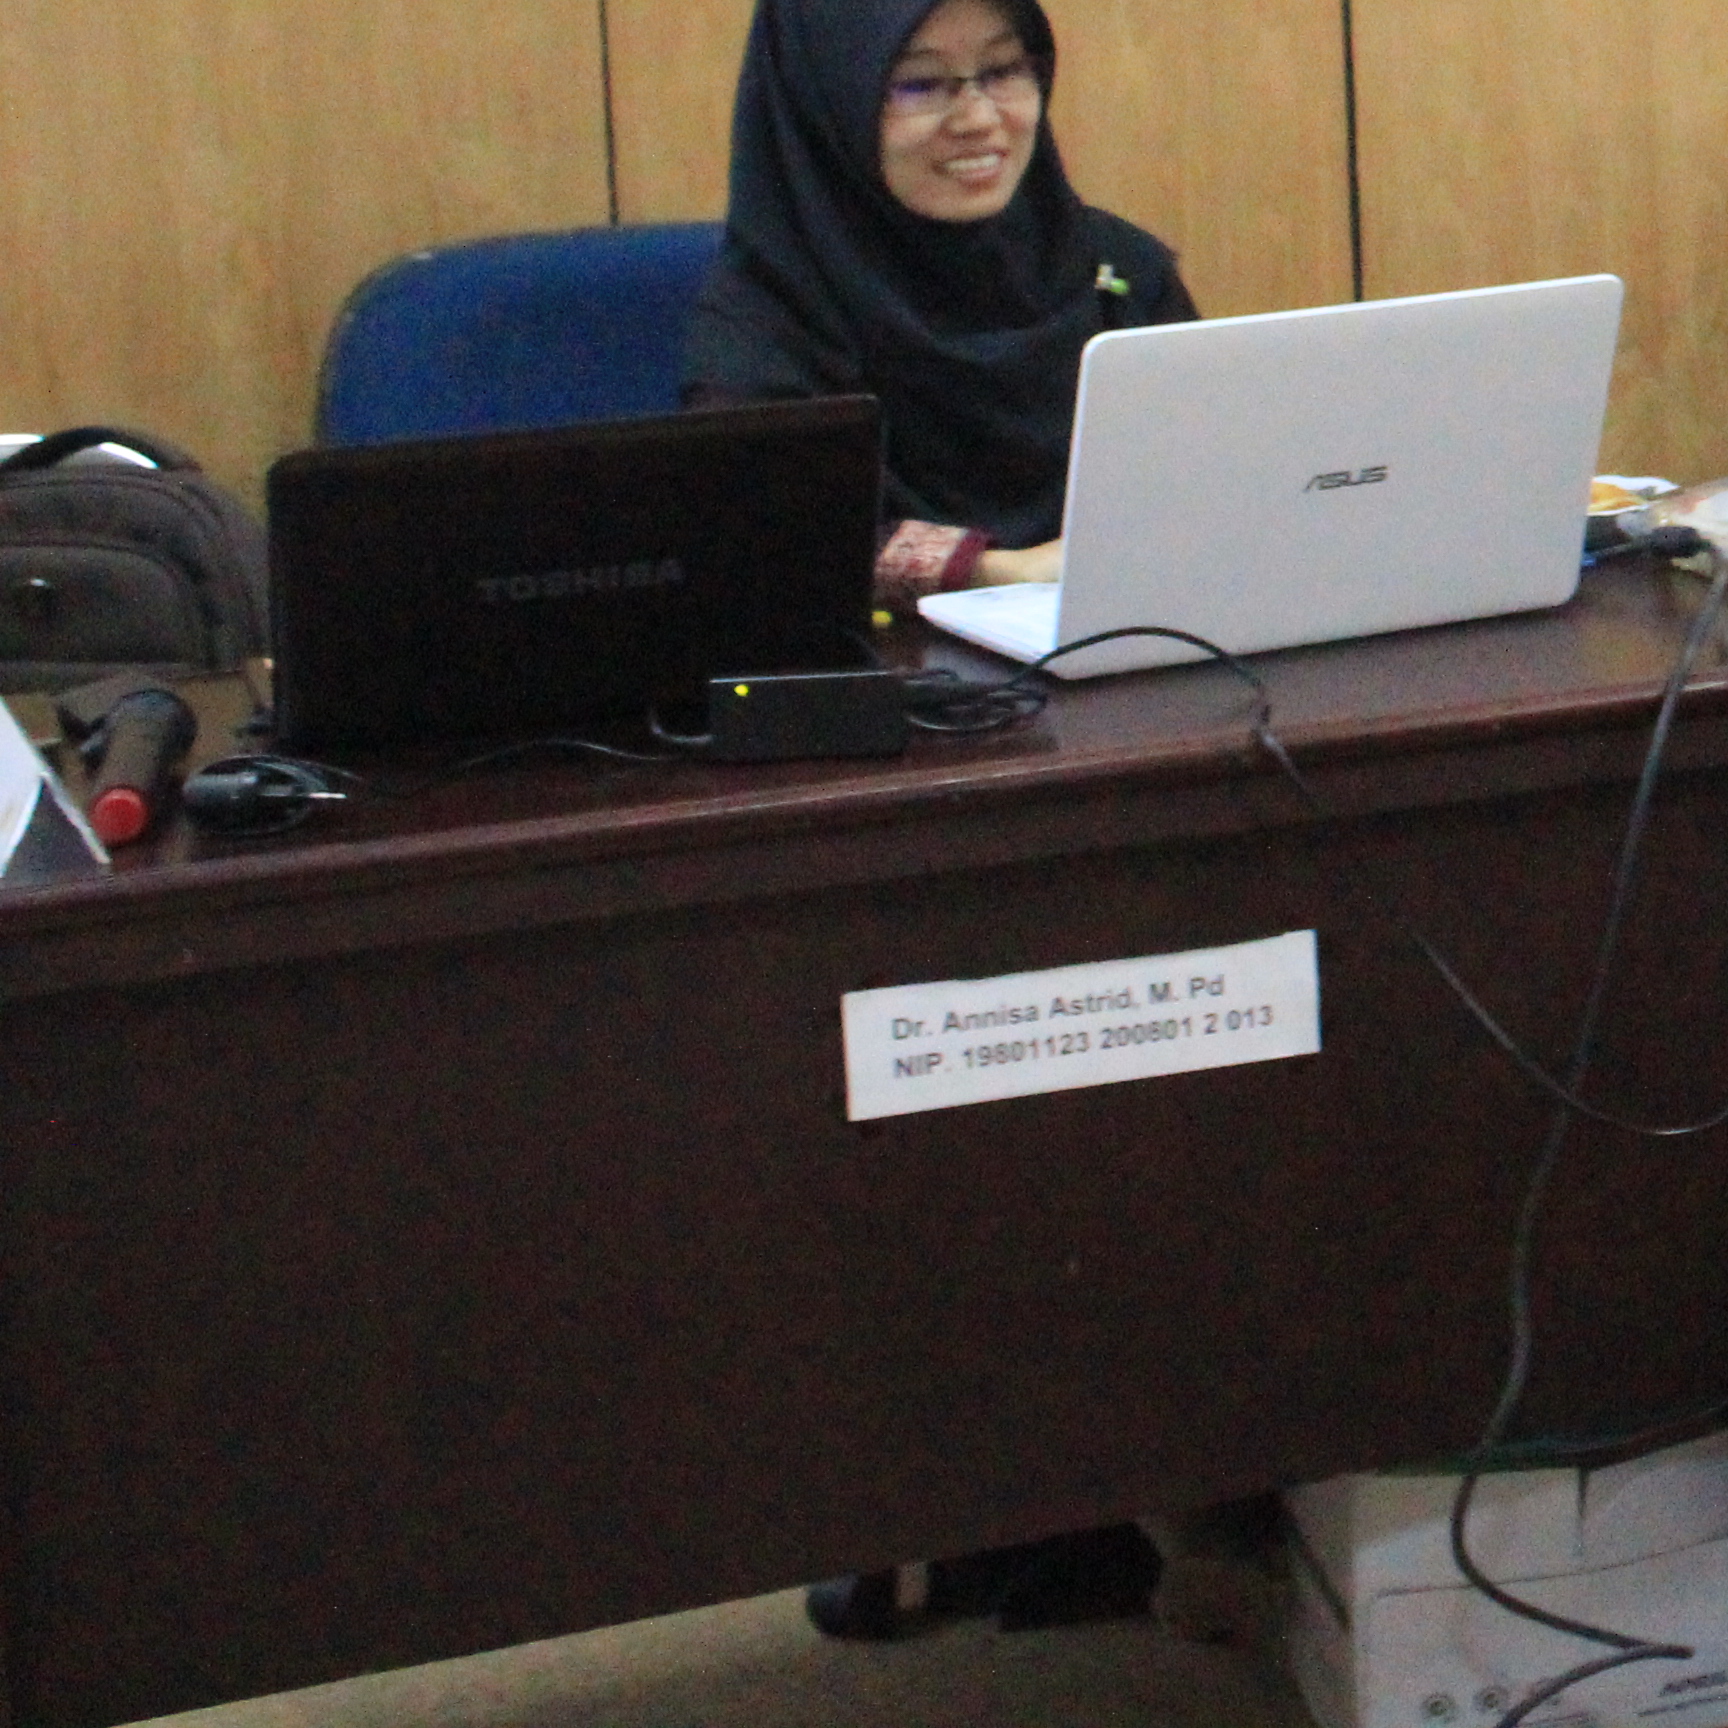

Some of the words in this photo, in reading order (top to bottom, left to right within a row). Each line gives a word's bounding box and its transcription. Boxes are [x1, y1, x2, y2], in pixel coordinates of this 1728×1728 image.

[1302, 465, 1389, 493] ASUS
[475, 557, 685, 603] TOSHIBA
[891, 1016, 934, 1042] Dr.
[942, 1005, 1042, 1036] Annisa
[1147, 981, 1181, 1006] M.
[1189, 974, 1226, 998] Pd
[893, 1051, 952, 1079] NIP.
[1202, 1011, 1219, 1036] 2
[1224, 1004, 1275, 1032] 013
